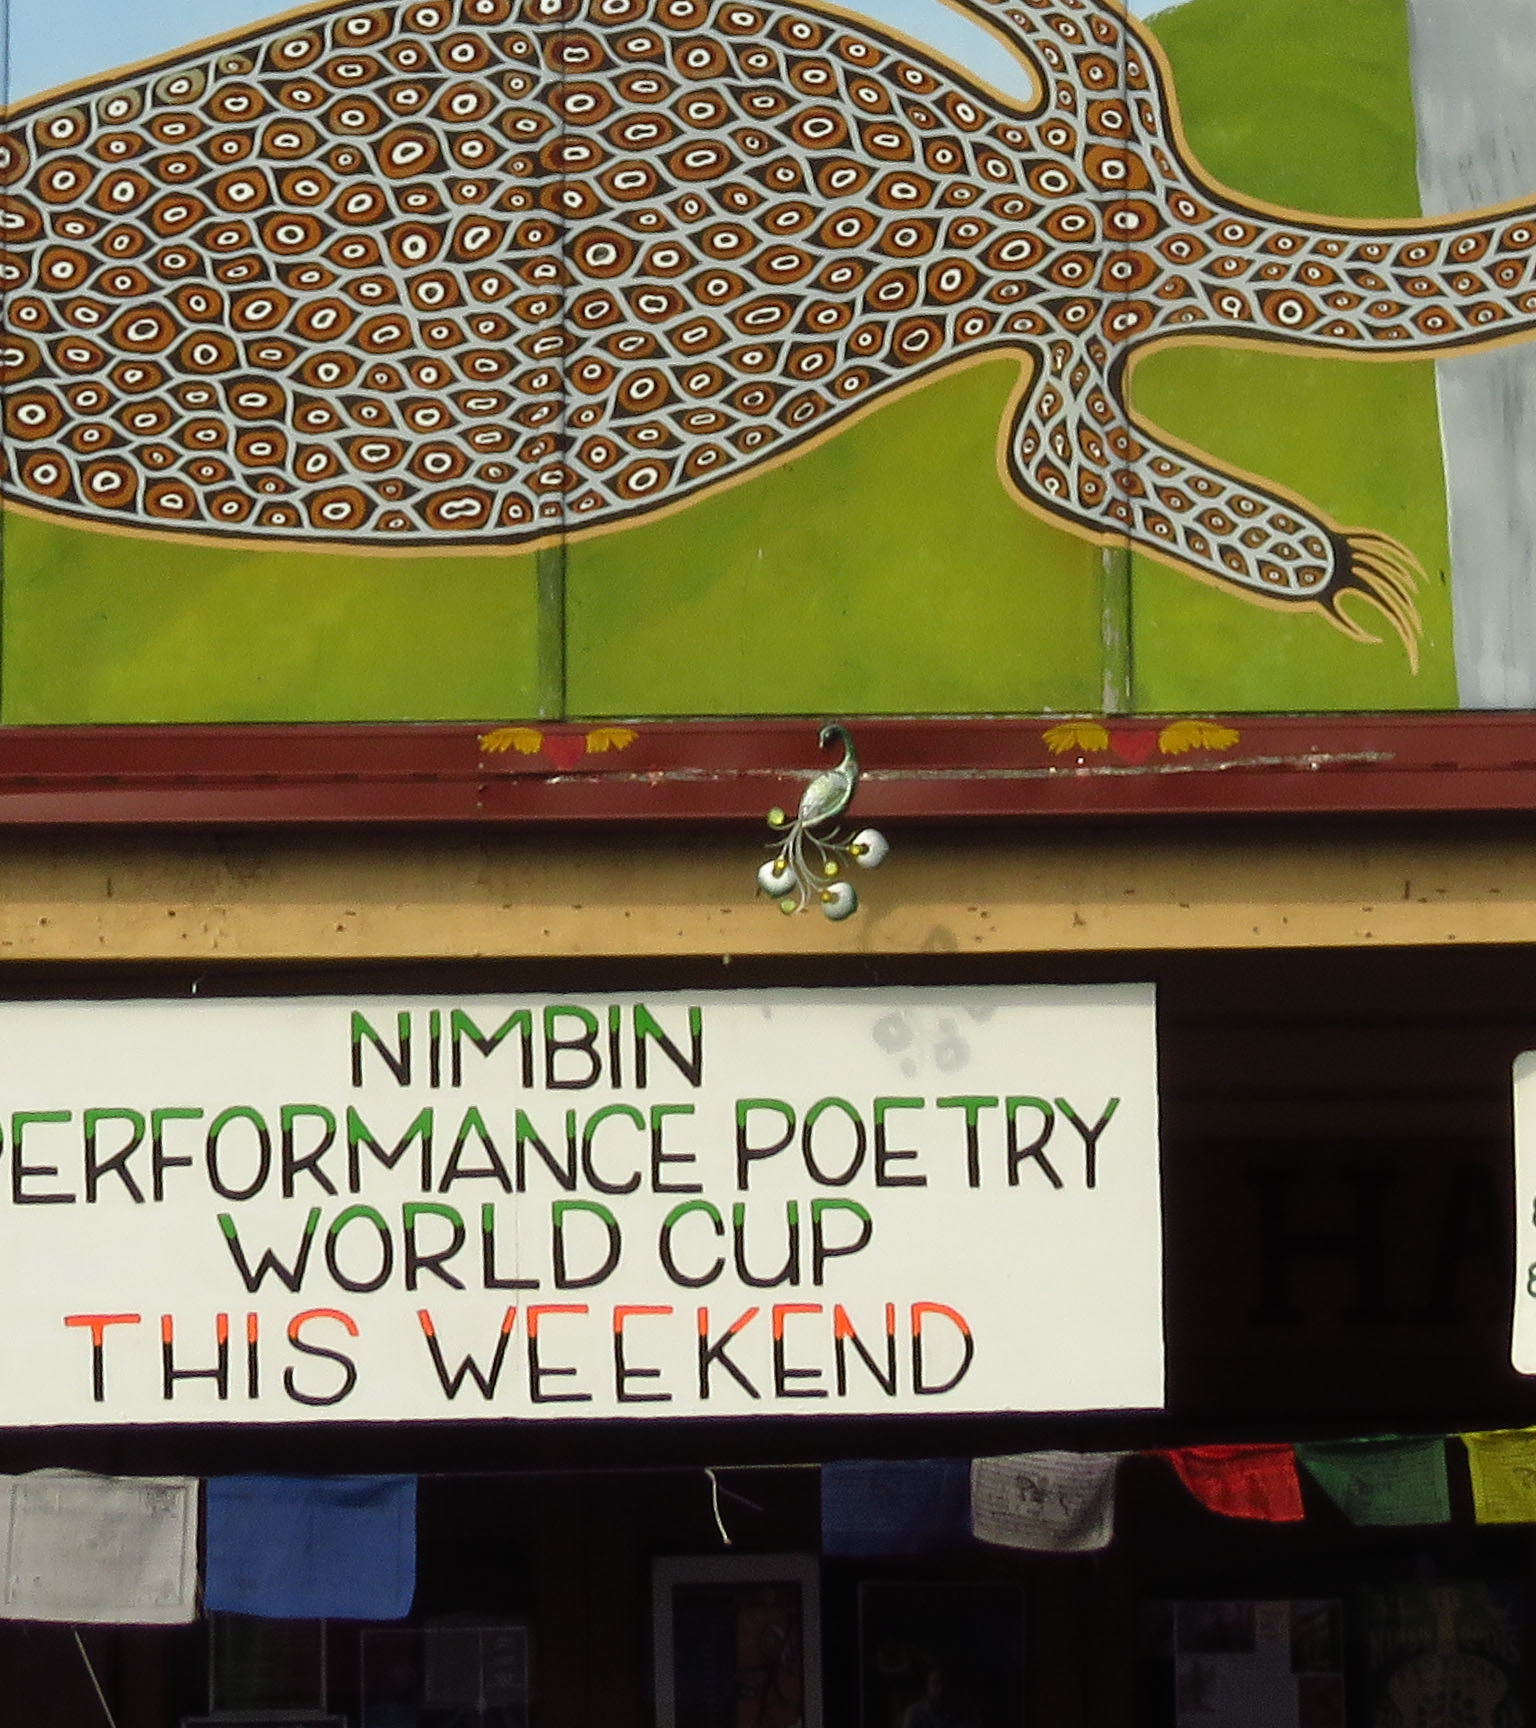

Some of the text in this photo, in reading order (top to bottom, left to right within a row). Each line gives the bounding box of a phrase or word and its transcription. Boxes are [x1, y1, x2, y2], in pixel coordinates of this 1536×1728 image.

[350, 1002, 703, 1090] NIMBIN
[735, 1095, 1121, 1191] POETRY
[216, 1197, 873, 1293] WORLD CUP
[64, 1301, 975, 1406] THIS WEEKEND
